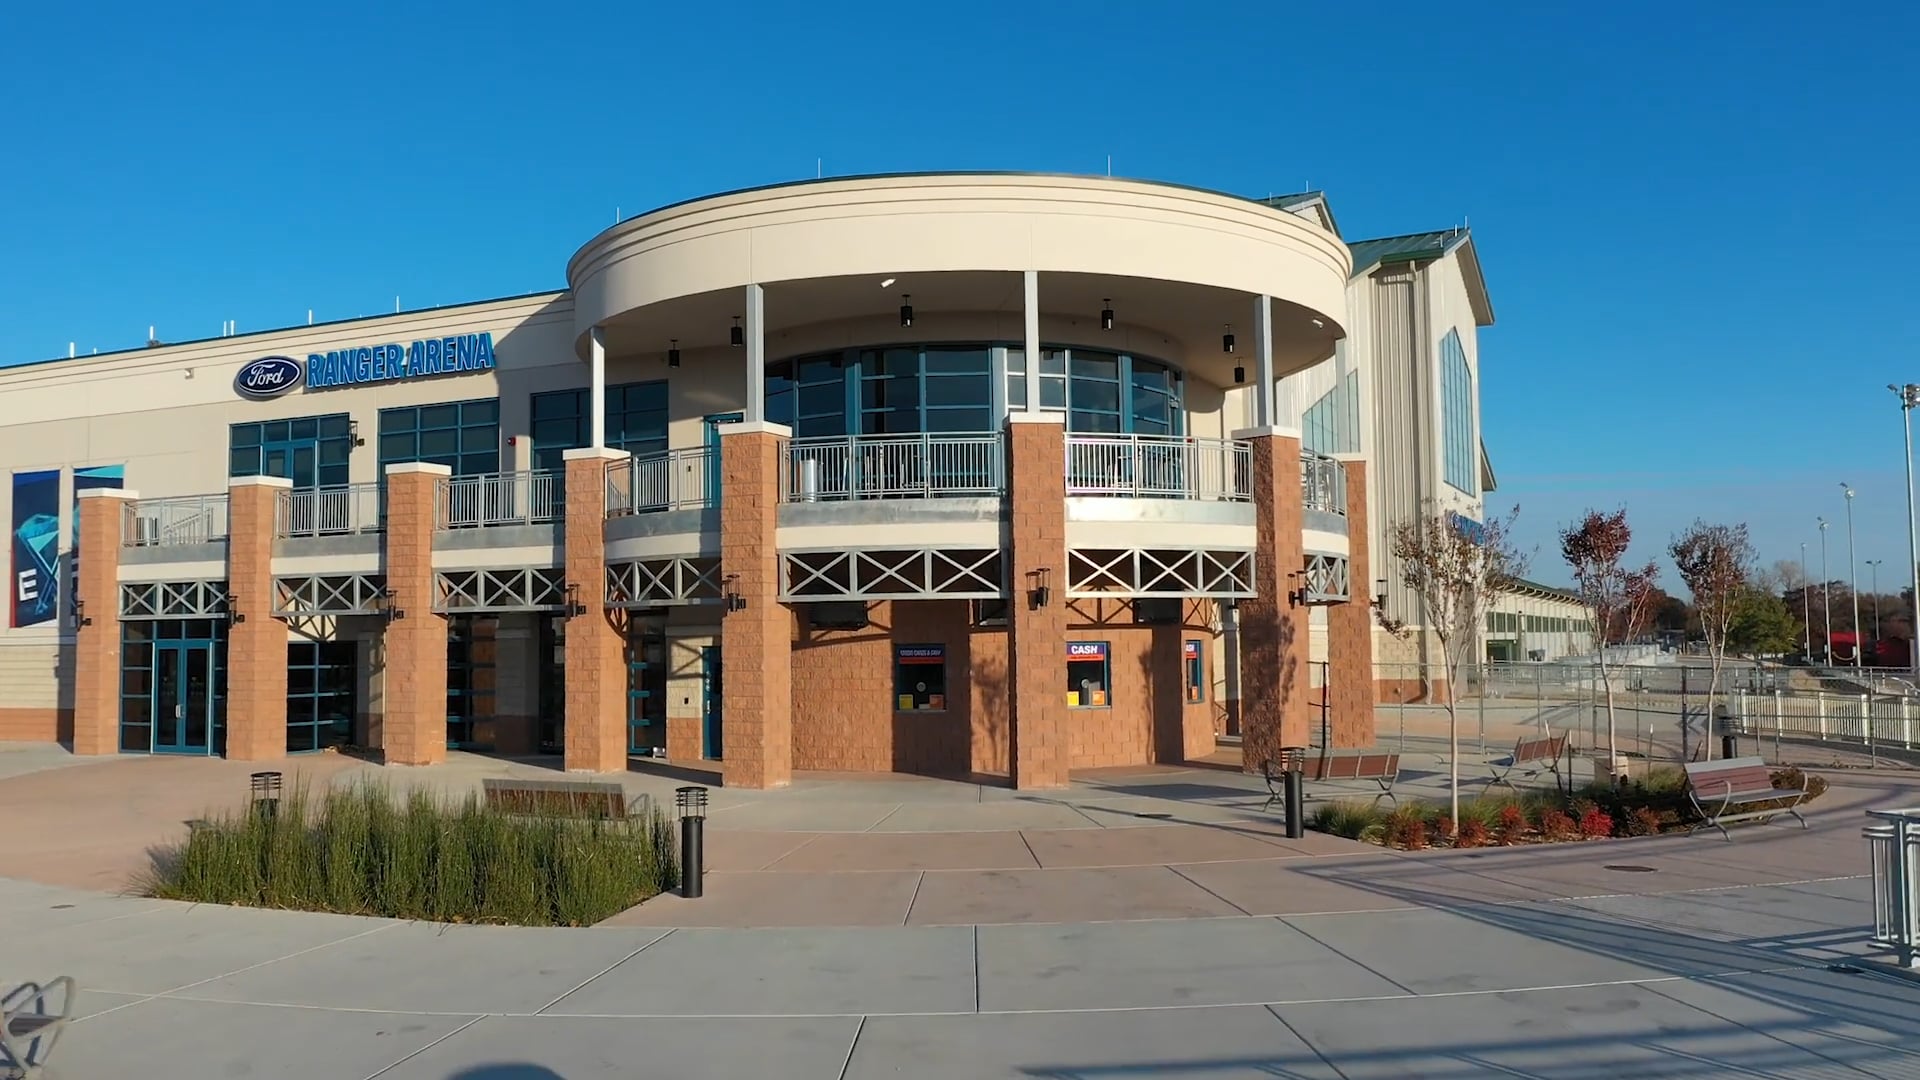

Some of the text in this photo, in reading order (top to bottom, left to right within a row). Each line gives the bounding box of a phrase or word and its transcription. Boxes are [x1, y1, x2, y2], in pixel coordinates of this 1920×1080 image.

[246, 332, 495, 388] Ford RANGER ARENA
[1071, 645, 1098, 655] CASH
